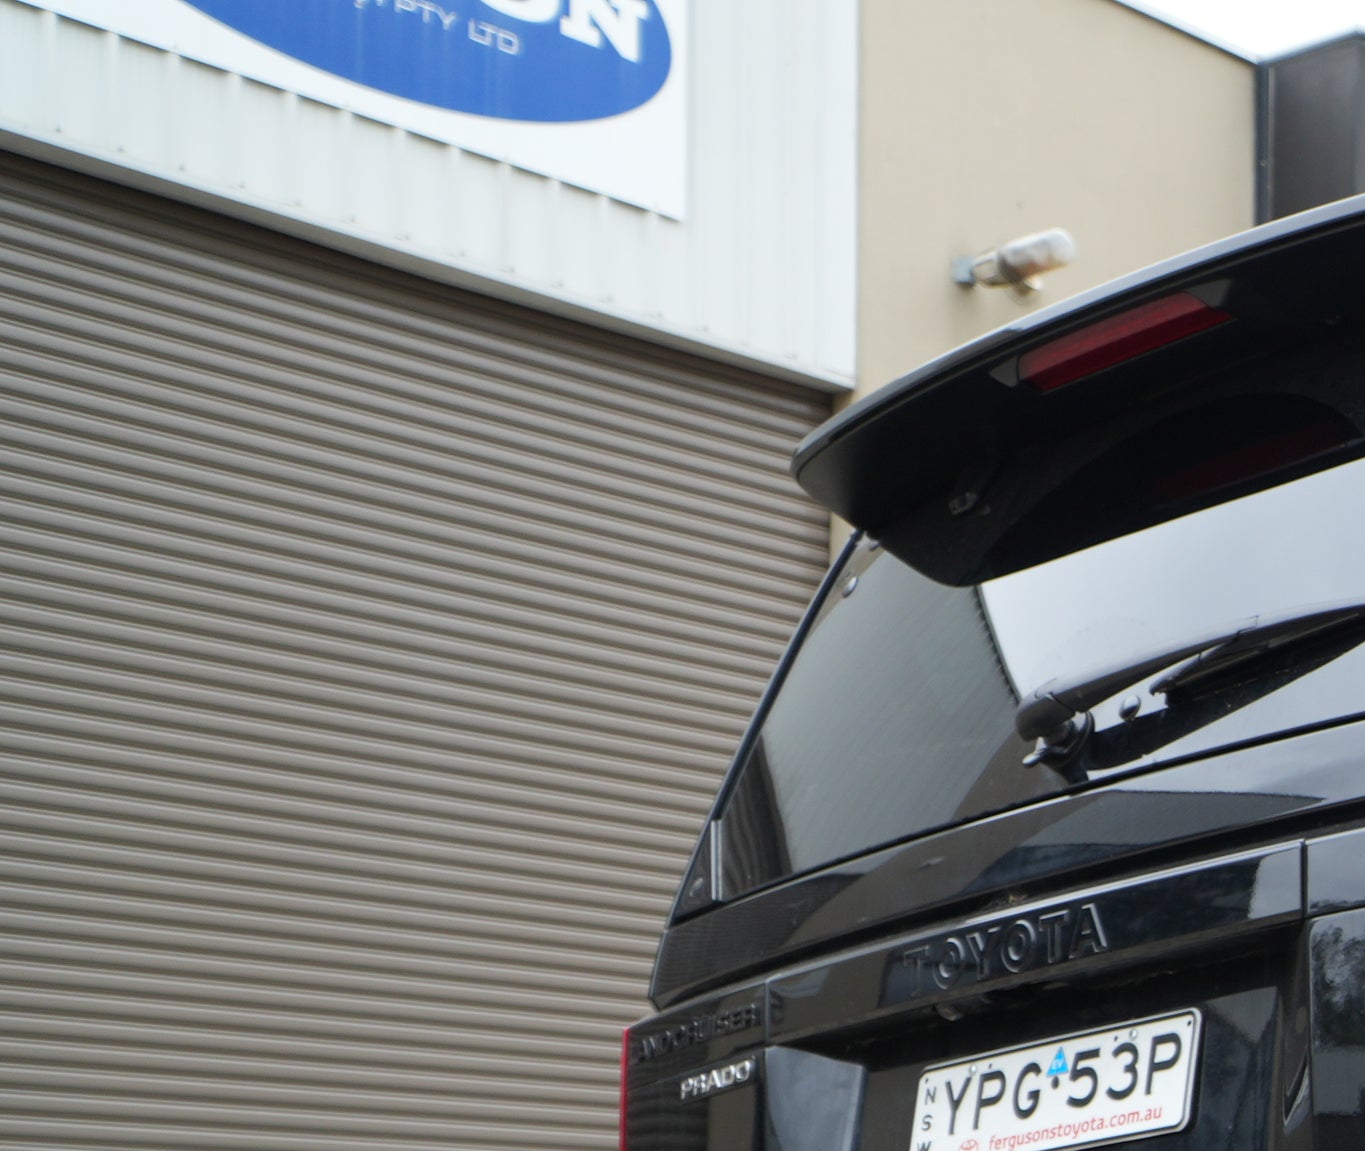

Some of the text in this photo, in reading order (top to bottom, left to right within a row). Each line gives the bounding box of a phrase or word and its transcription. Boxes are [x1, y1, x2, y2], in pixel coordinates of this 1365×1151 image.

[467, 18, 520, 55] LTD
[903, 903, 1108, 997] TOYOTA
[680, 1058, 753, 1101] PRADO
[988, 1106, 1163, 1151] fergusonstoyota.com.au
